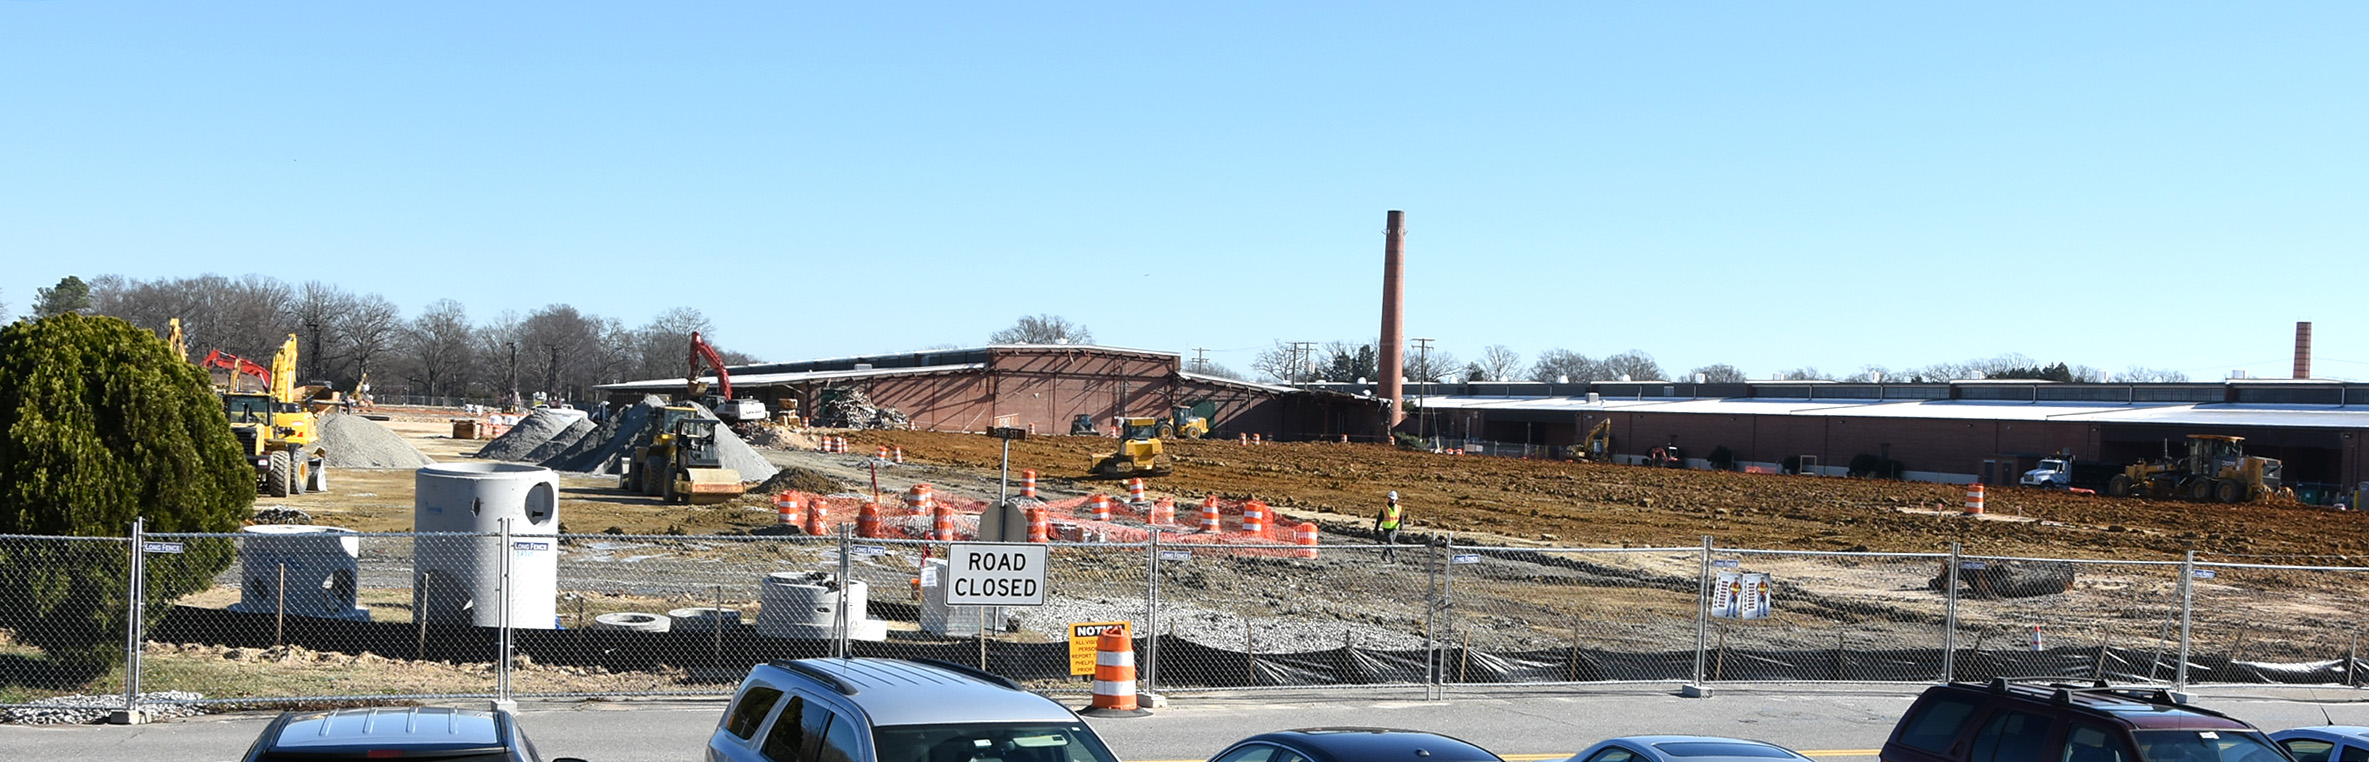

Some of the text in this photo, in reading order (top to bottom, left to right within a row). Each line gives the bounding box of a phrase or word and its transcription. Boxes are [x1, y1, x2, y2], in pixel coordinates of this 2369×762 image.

[994, 428, 1019, 438] 5TH ST
[145, 543, 181, 552] LONG FENCE
[514, 542, 548, 551] LONG FENCE
[968, 552, 1026, 571] ROAD
[955, 578, 1037, 597] CLOSED
